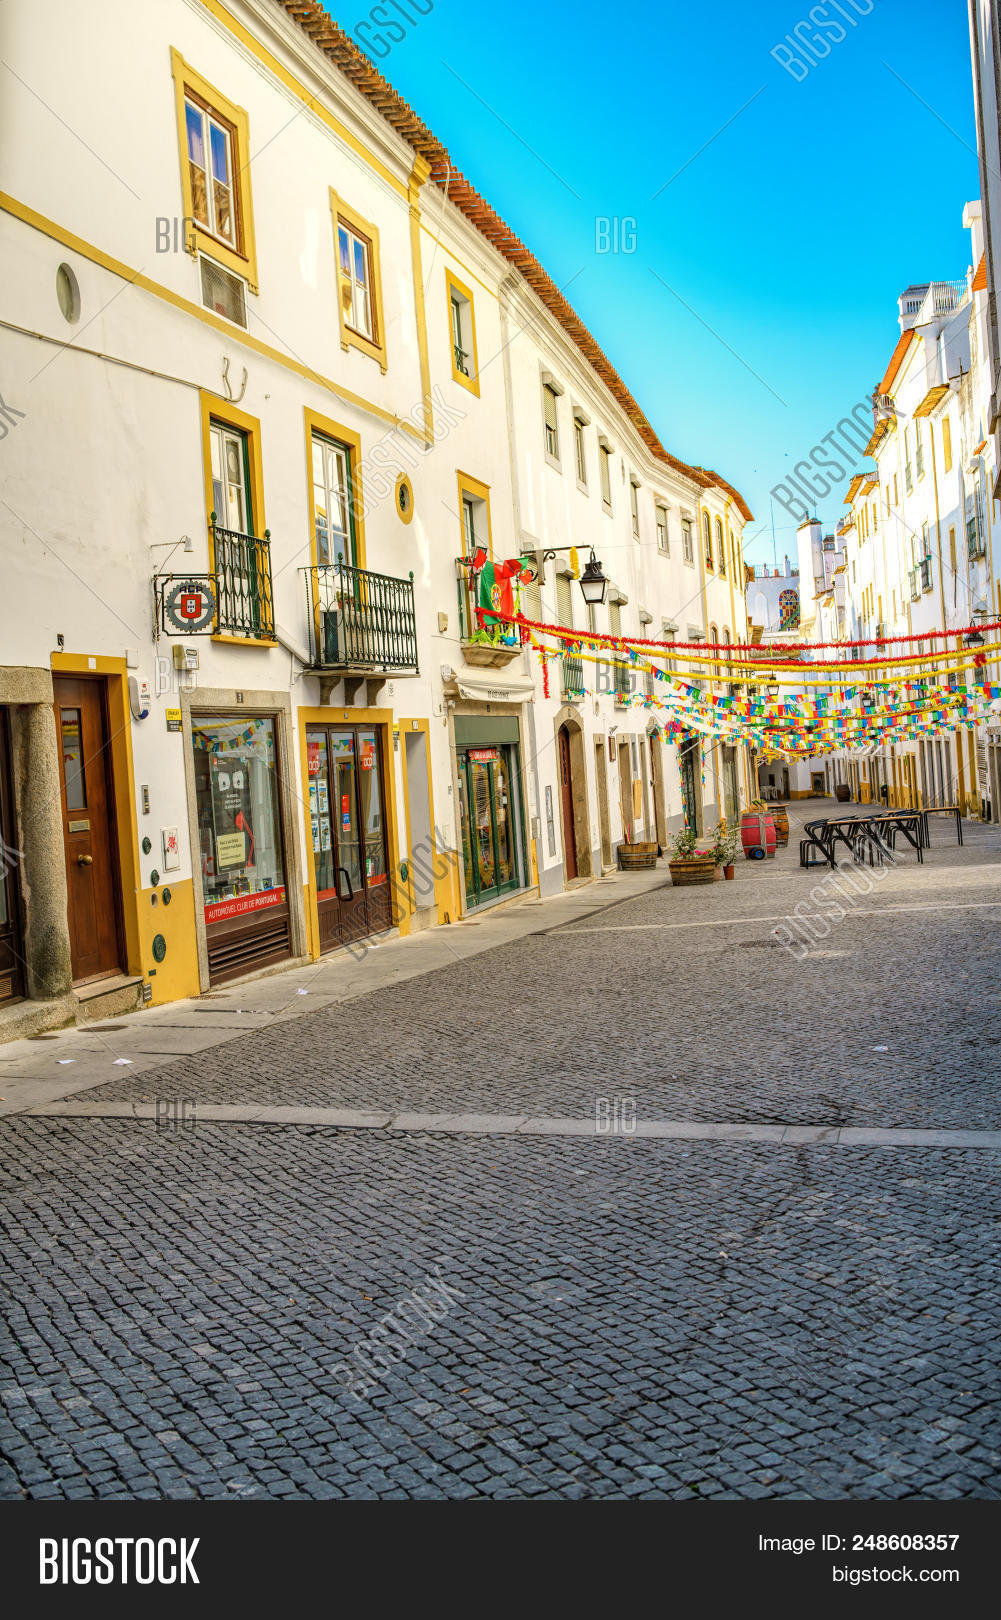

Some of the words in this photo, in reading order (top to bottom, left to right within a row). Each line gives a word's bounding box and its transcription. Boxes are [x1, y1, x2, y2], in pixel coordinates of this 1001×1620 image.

[179, 584, 203, 593] ACP
[208, 904, 237, 919] AUTOMÓVEL
[236, 901, 249, 912] CLUB
[249, 899, 255, 909] DE
[255, 894, 278, 907] PORTUGAL
